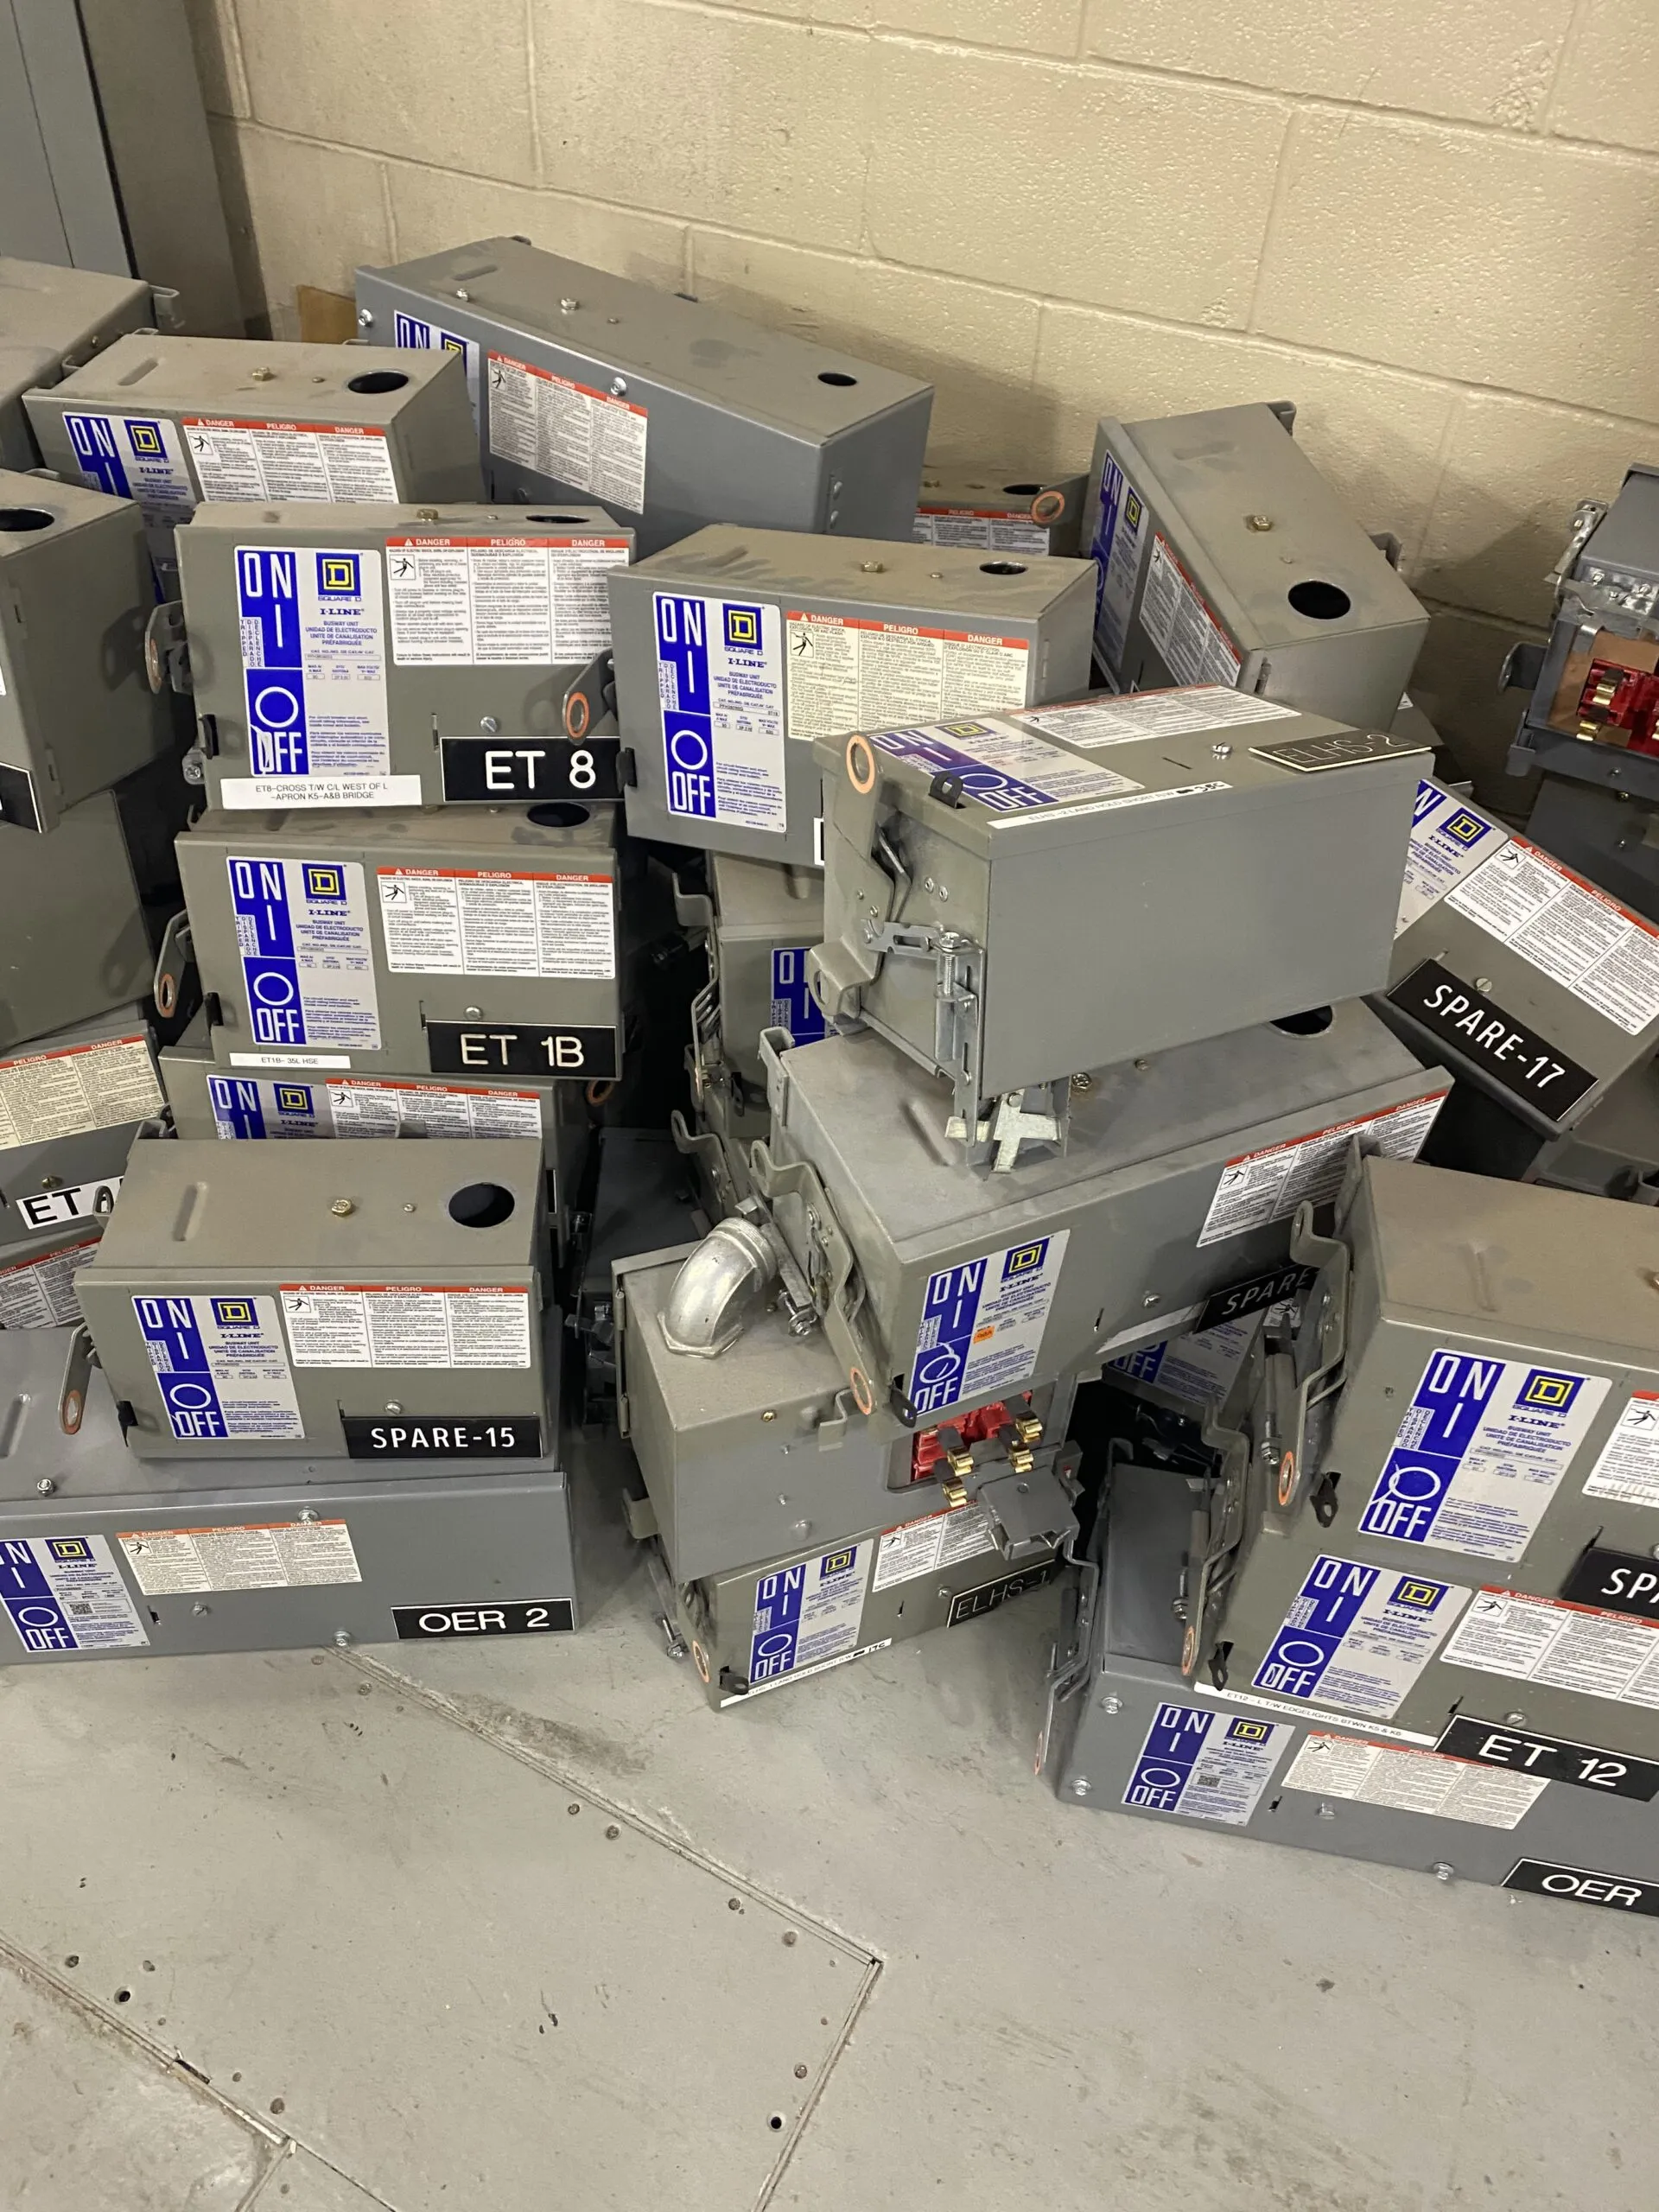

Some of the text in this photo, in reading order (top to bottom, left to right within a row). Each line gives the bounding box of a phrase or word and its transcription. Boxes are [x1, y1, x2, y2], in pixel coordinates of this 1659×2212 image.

[399, 318, 429, 349] ON
[70, 417, 115, 458] ON
[266, 423, 296, 431] PELIGRO
[334, 427, 365, 435] DANGER
[1103, 458, 1122, 505] ON
[244, 552, 292, 598] ON
[661, 598, 702, 646] ON
[810, 614, 844, 626] DANGER
[883, 624, 918, 635] PELIGRO
[724, 646, 753, 655] SQUARE
[968, 634, 1003, 646] DANGER
[257, 731, 302, 772] OFF
[869, 731, 934, 750] ON
[1272, 734, 1410, 764] ELHS-2
[486, 750, 596, 790] ET 8
[343, 791, 374, 799] BRIDGE
[672, 771, 711, 814] OFF
[979, 786, 1044, 809] OFF
[1534, 851, 1563, 871] DANGER
[235, 862, 282, 900] ON
[1591, 889, 1622, 912] PELIGRO
[257, 1007, 300, 1042] OFF
[1423, 984, 1565, 1088] SPARE-17
[91, 1039, 123, 1050] DANGER
[461, 1034, 584, 1067] ET 1B
[13, 1055, 47, 1066] PELIGRO
[215, 1080, 257, 1111] ON
[351, 1079, 382, 1088] DANGER
[416, 1084, 448, 1092] PELIGRO
[1395, 1097, 1427, 1111] DANGER
[1322, 1121, 1356, 1135] PELIGRO
[1257, 1143, 1287, 1157] DANGER
[22, 1187, 81, 1226] ET
[932, 1262, 981, 1305] ON
[141, 1300, 192, 1328] ON
[1428, 1355, 1497, 1401] ON
[914, 1377, 957, 1413] OFF
[175, 1411, 219, 1436] OFF
[1513, 1404, 1554, 1416] SQUARE
[371, 1427, 515, 1449] SPARE-15
[1368, 1500, 1432, 1538] OFF
[763, 1567, 801, 1599] ON
[1313, 1560, 1373, 1597] ON
[1601, 1568, 1659, 1605] SP
[956, 1570, 1046, 1618] ELHS-1
[1514, 1592, 1555, 1605] DANGER
[418, 1608, 550, 1632] OER 2
[1600, 1611, 1643, 1624] PELIGRO
[26, 1628, 68, 1649] OFF
[754, 1650, 791, 1680] OFF
[1261, 1662, 1316, 1694] OFF
[1160, 1707, 1209, 1733] ON
[1265, 1700, 1282, 1709] T/W
[1283, 1705, 1339, 1722] EDGELIGHTS
[1341, 1718, 1366, 1728] BTWN
[1335, 1735, 1369, 1745] DANGER
[1409, 1748, 1446, 1758] PELIGRO
[1478, 1734, 1627, 1787] ET 12
[1131, 1784, 1176, 1808] OFF
[1541, 1873, 1643, 1906] OER
